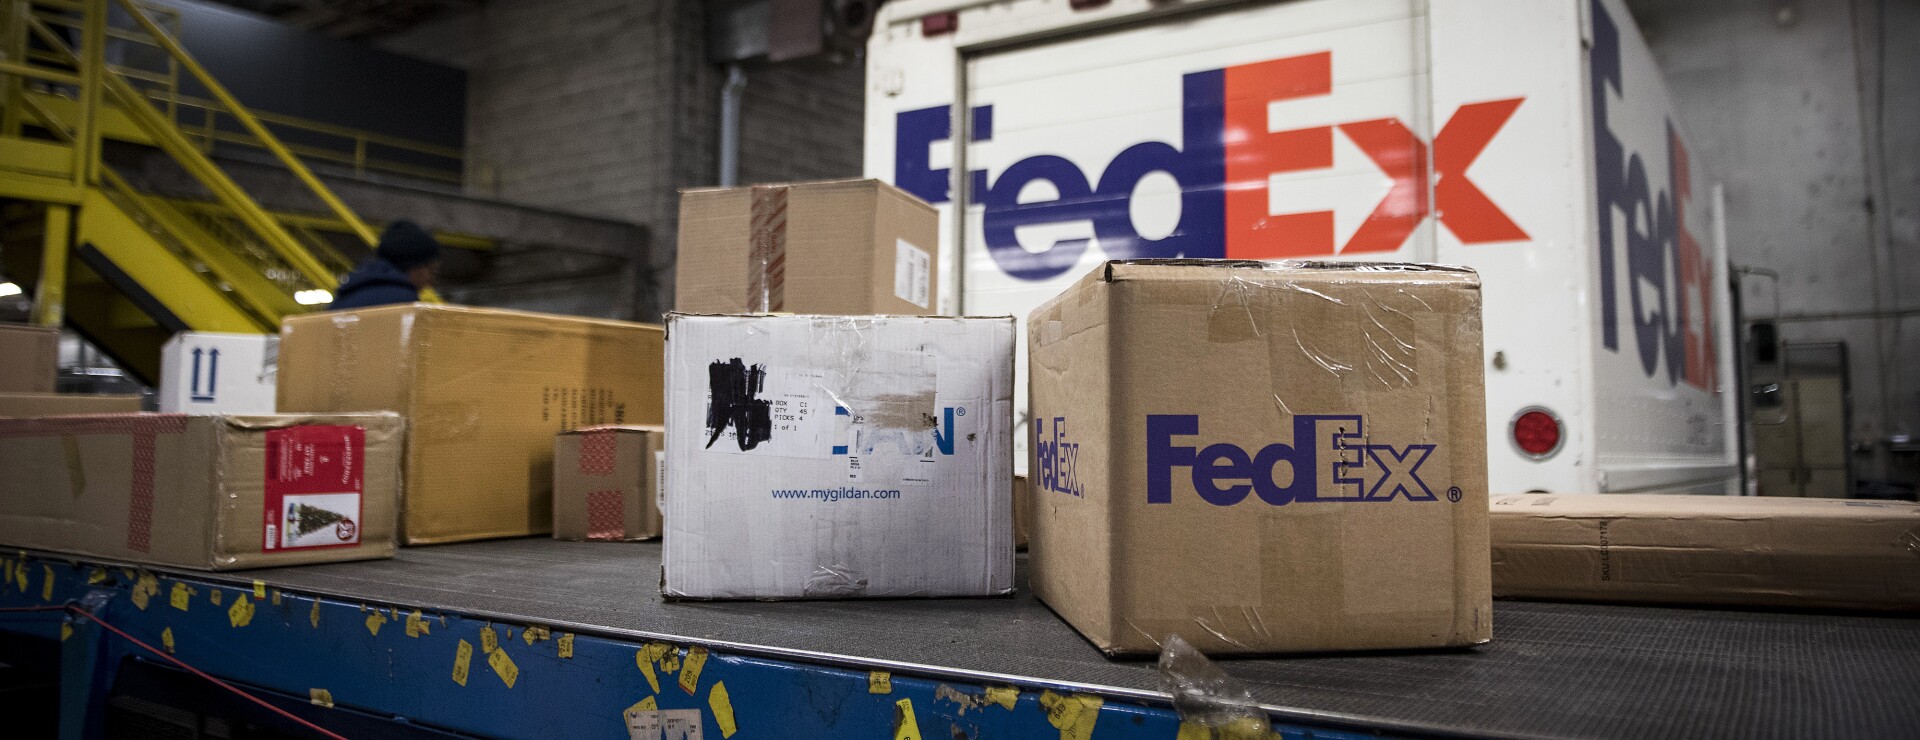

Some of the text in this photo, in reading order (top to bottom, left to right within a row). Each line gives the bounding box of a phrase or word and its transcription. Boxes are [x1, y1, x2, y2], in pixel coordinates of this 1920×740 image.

[895, 50, 1532, 282] FedEx
[771, 487, 901, 502] www.mygildan.com
[1036, 416, 1080, 496] FedEx
[1147, 414, 1439, 506] FedEx
